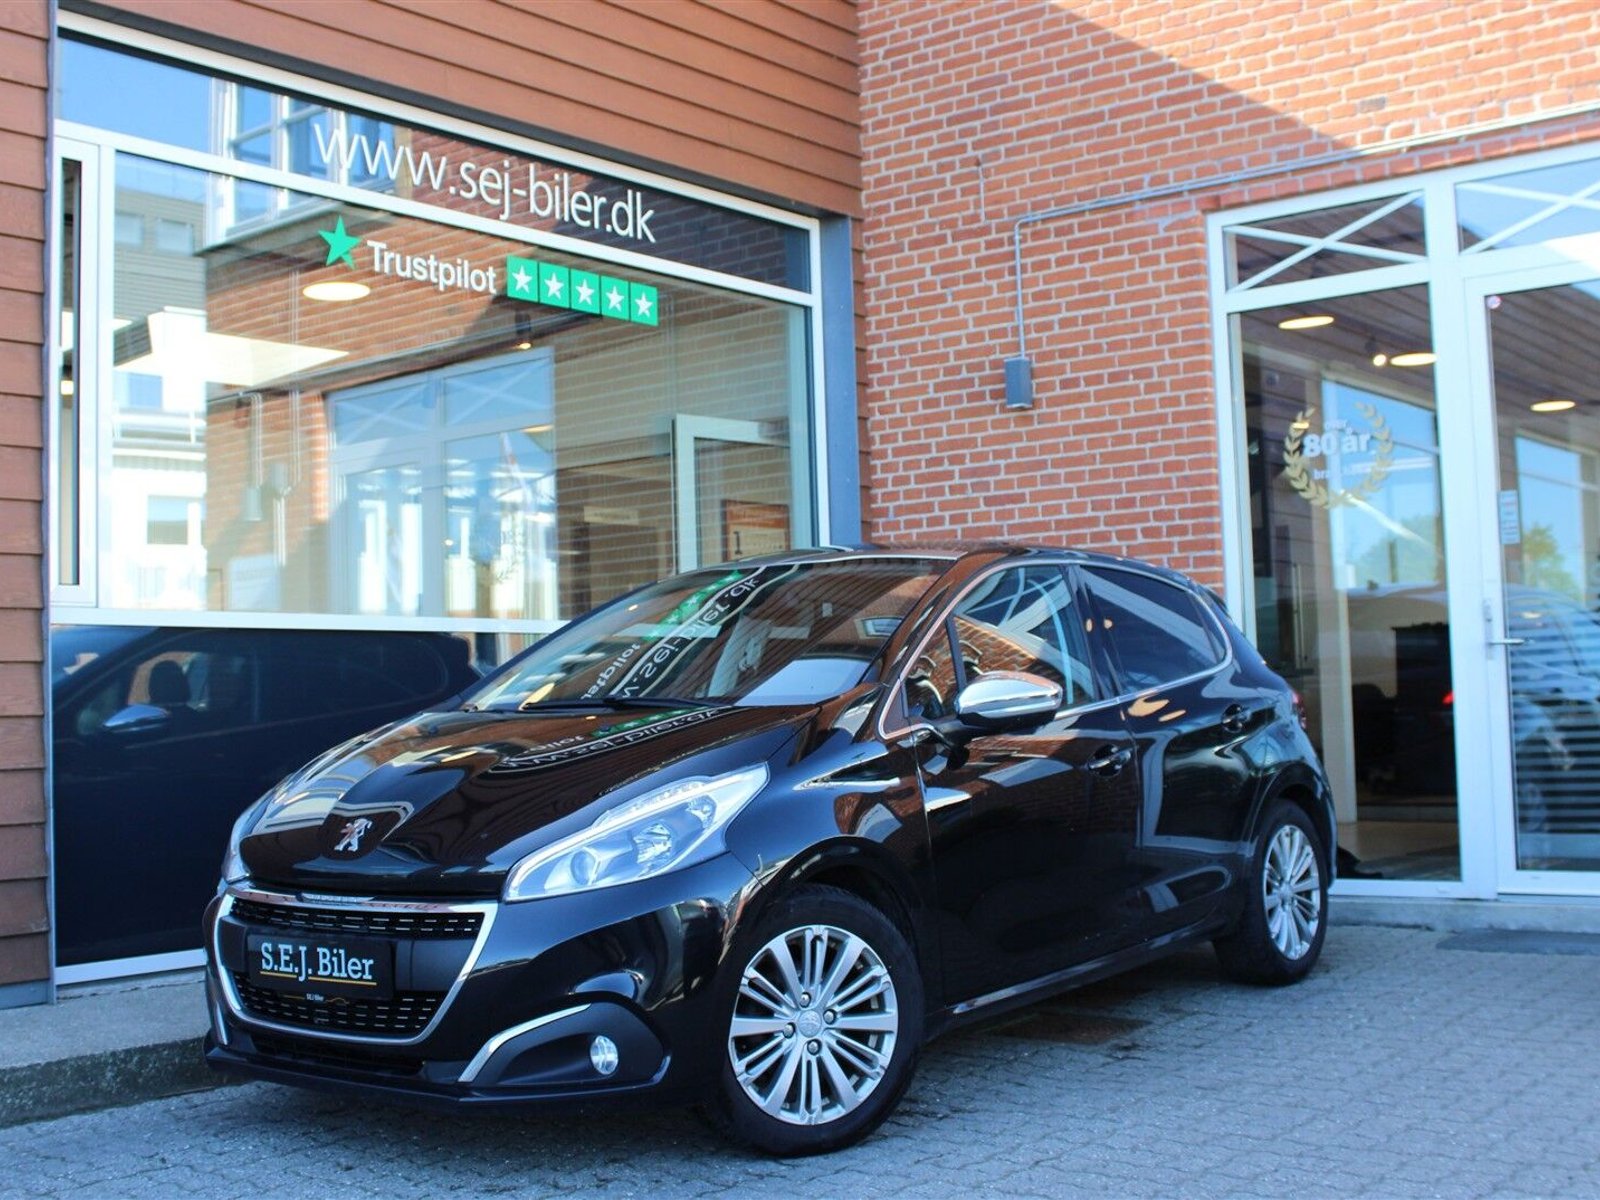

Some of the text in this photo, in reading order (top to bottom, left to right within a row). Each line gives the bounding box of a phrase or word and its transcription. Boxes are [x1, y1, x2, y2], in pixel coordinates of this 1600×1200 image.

[314, 122, 656, 243] www.sej-biler.dk
[367, 240, 497, 294] Trustpilot
[1303, 426, 1371, 457] 80 år
[261, 942, 374, 982] S.E.J. Biler
